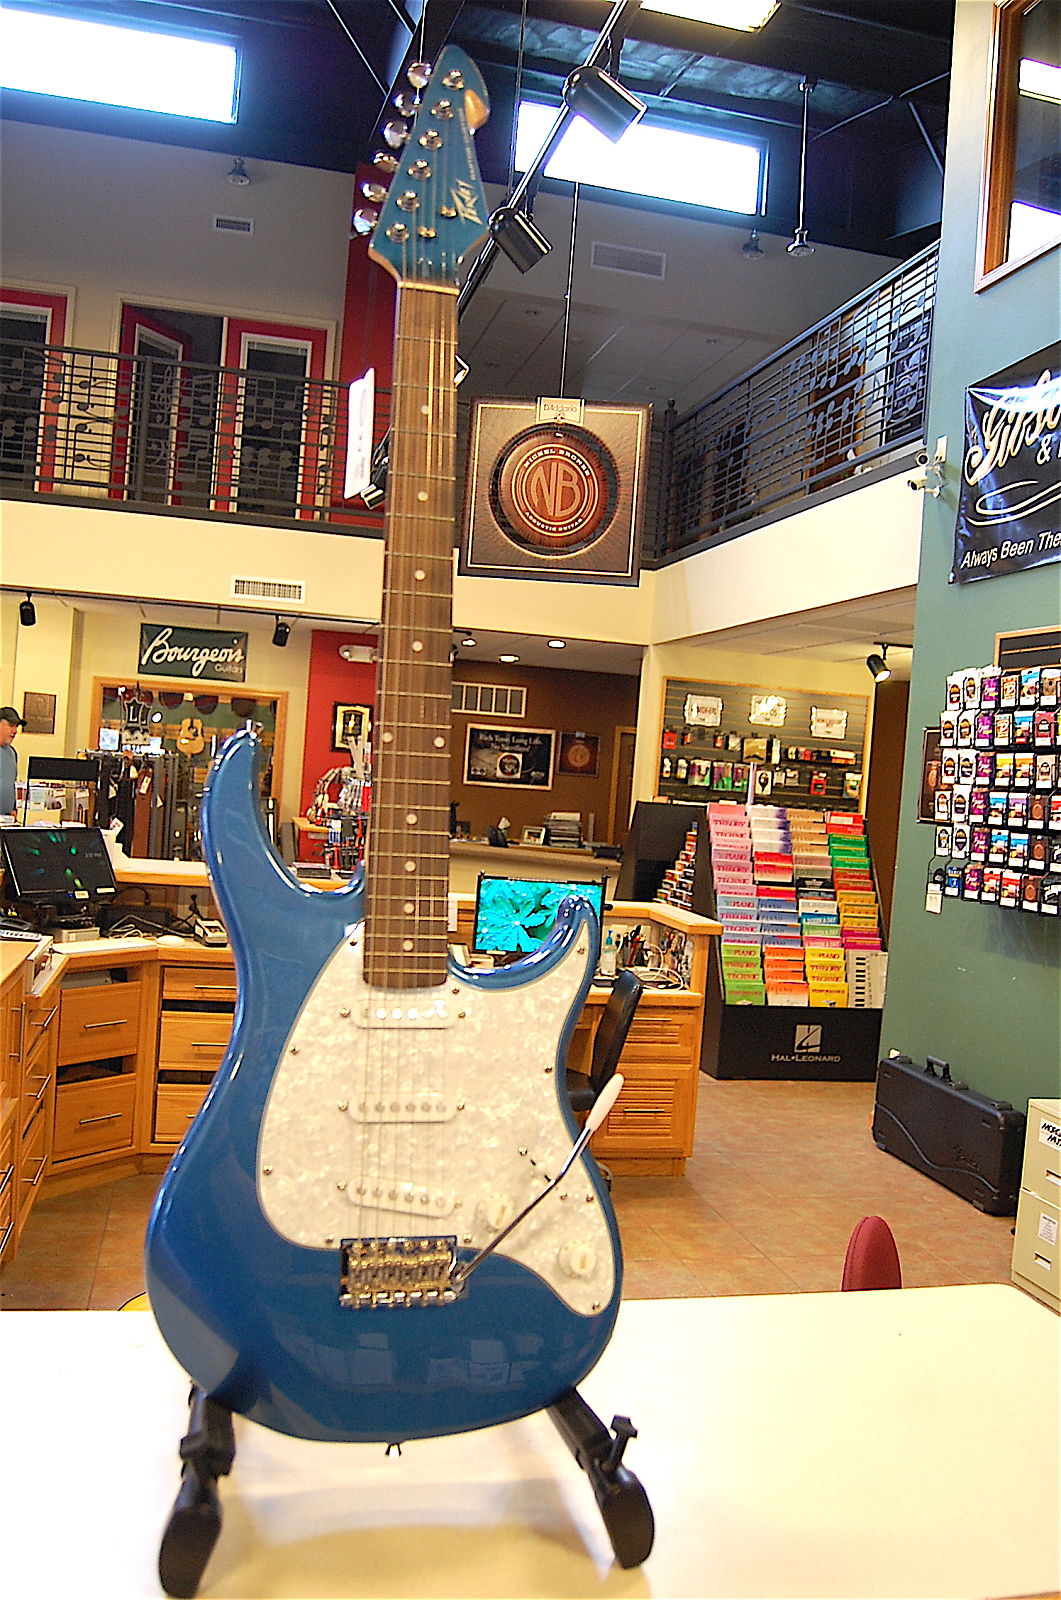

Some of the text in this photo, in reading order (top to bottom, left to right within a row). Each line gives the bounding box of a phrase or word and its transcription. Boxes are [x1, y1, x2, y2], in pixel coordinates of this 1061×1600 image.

[531, 462, 580, 517] NB
[960, 547, 998, 569] Always
[1001, 540, 1034, 559] Been
[141, 627, 244, 677] Bourgeois
